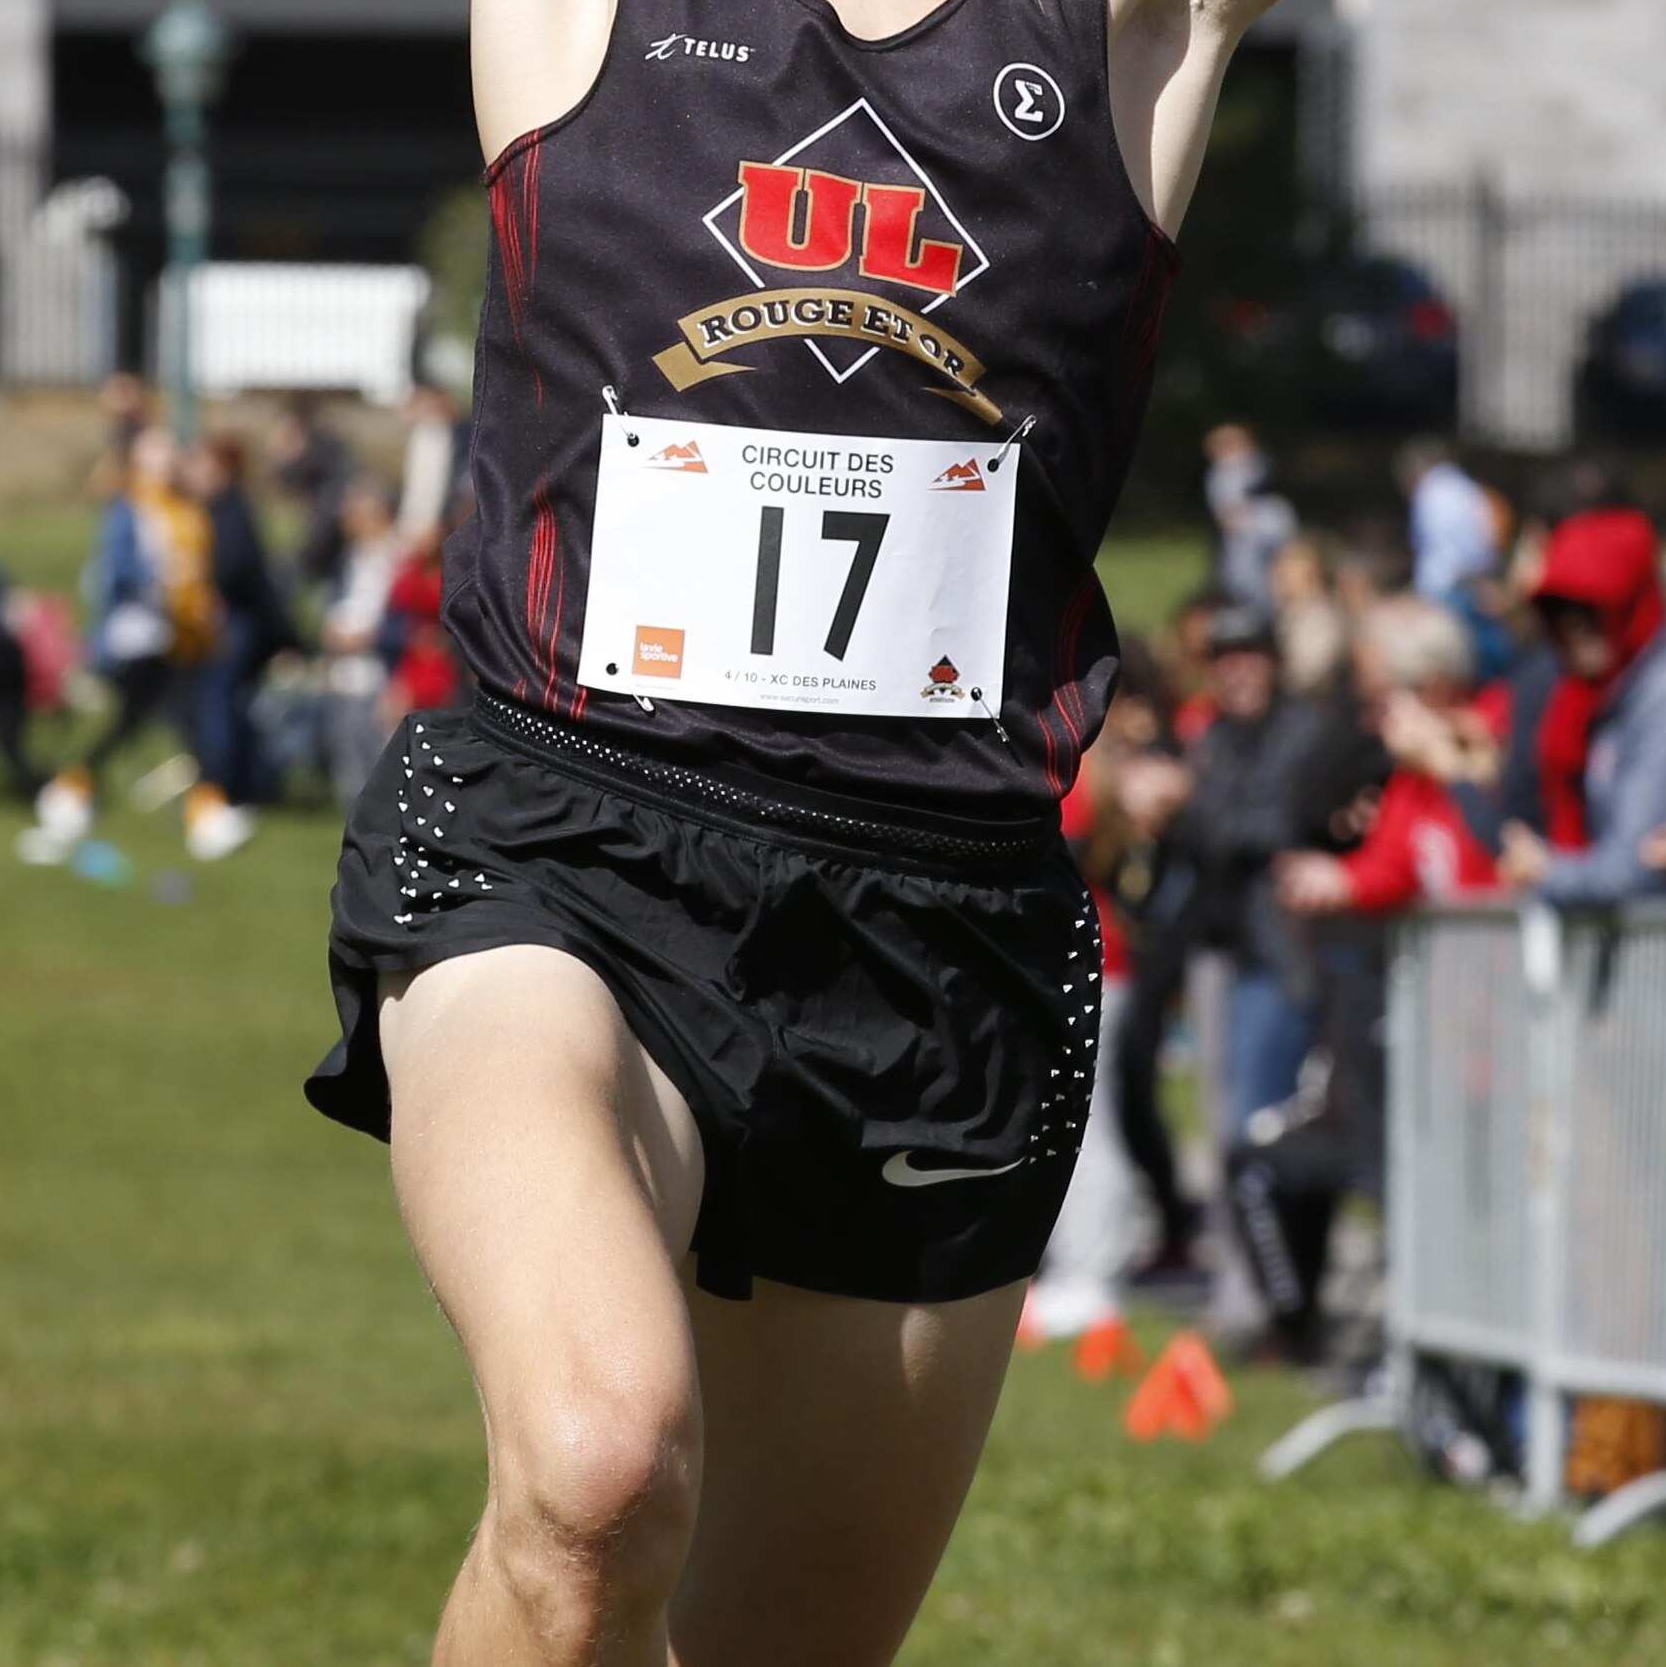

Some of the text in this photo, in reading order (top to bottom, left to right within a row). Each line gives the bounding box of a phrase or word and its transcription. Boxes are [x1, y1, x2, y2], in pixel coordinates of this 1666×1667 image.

[684, 37, 749, 62] TELUS
[737, 160, 964, 297] UL
[697, 298, 966, 376] ROUGE ET OR
[742, 444, 894, 474] CIRCUIT DES
[750, 471, 883, 499] COULEURS
[750, 505, 892, 662] 17
[724, 671, 732, 680] 4
[744, 672, 758, 683] 10
[770, 674, 788, 685] XC
[792, 676, 819, 688] DES
[822, 677, 877, 691] PLAINES
